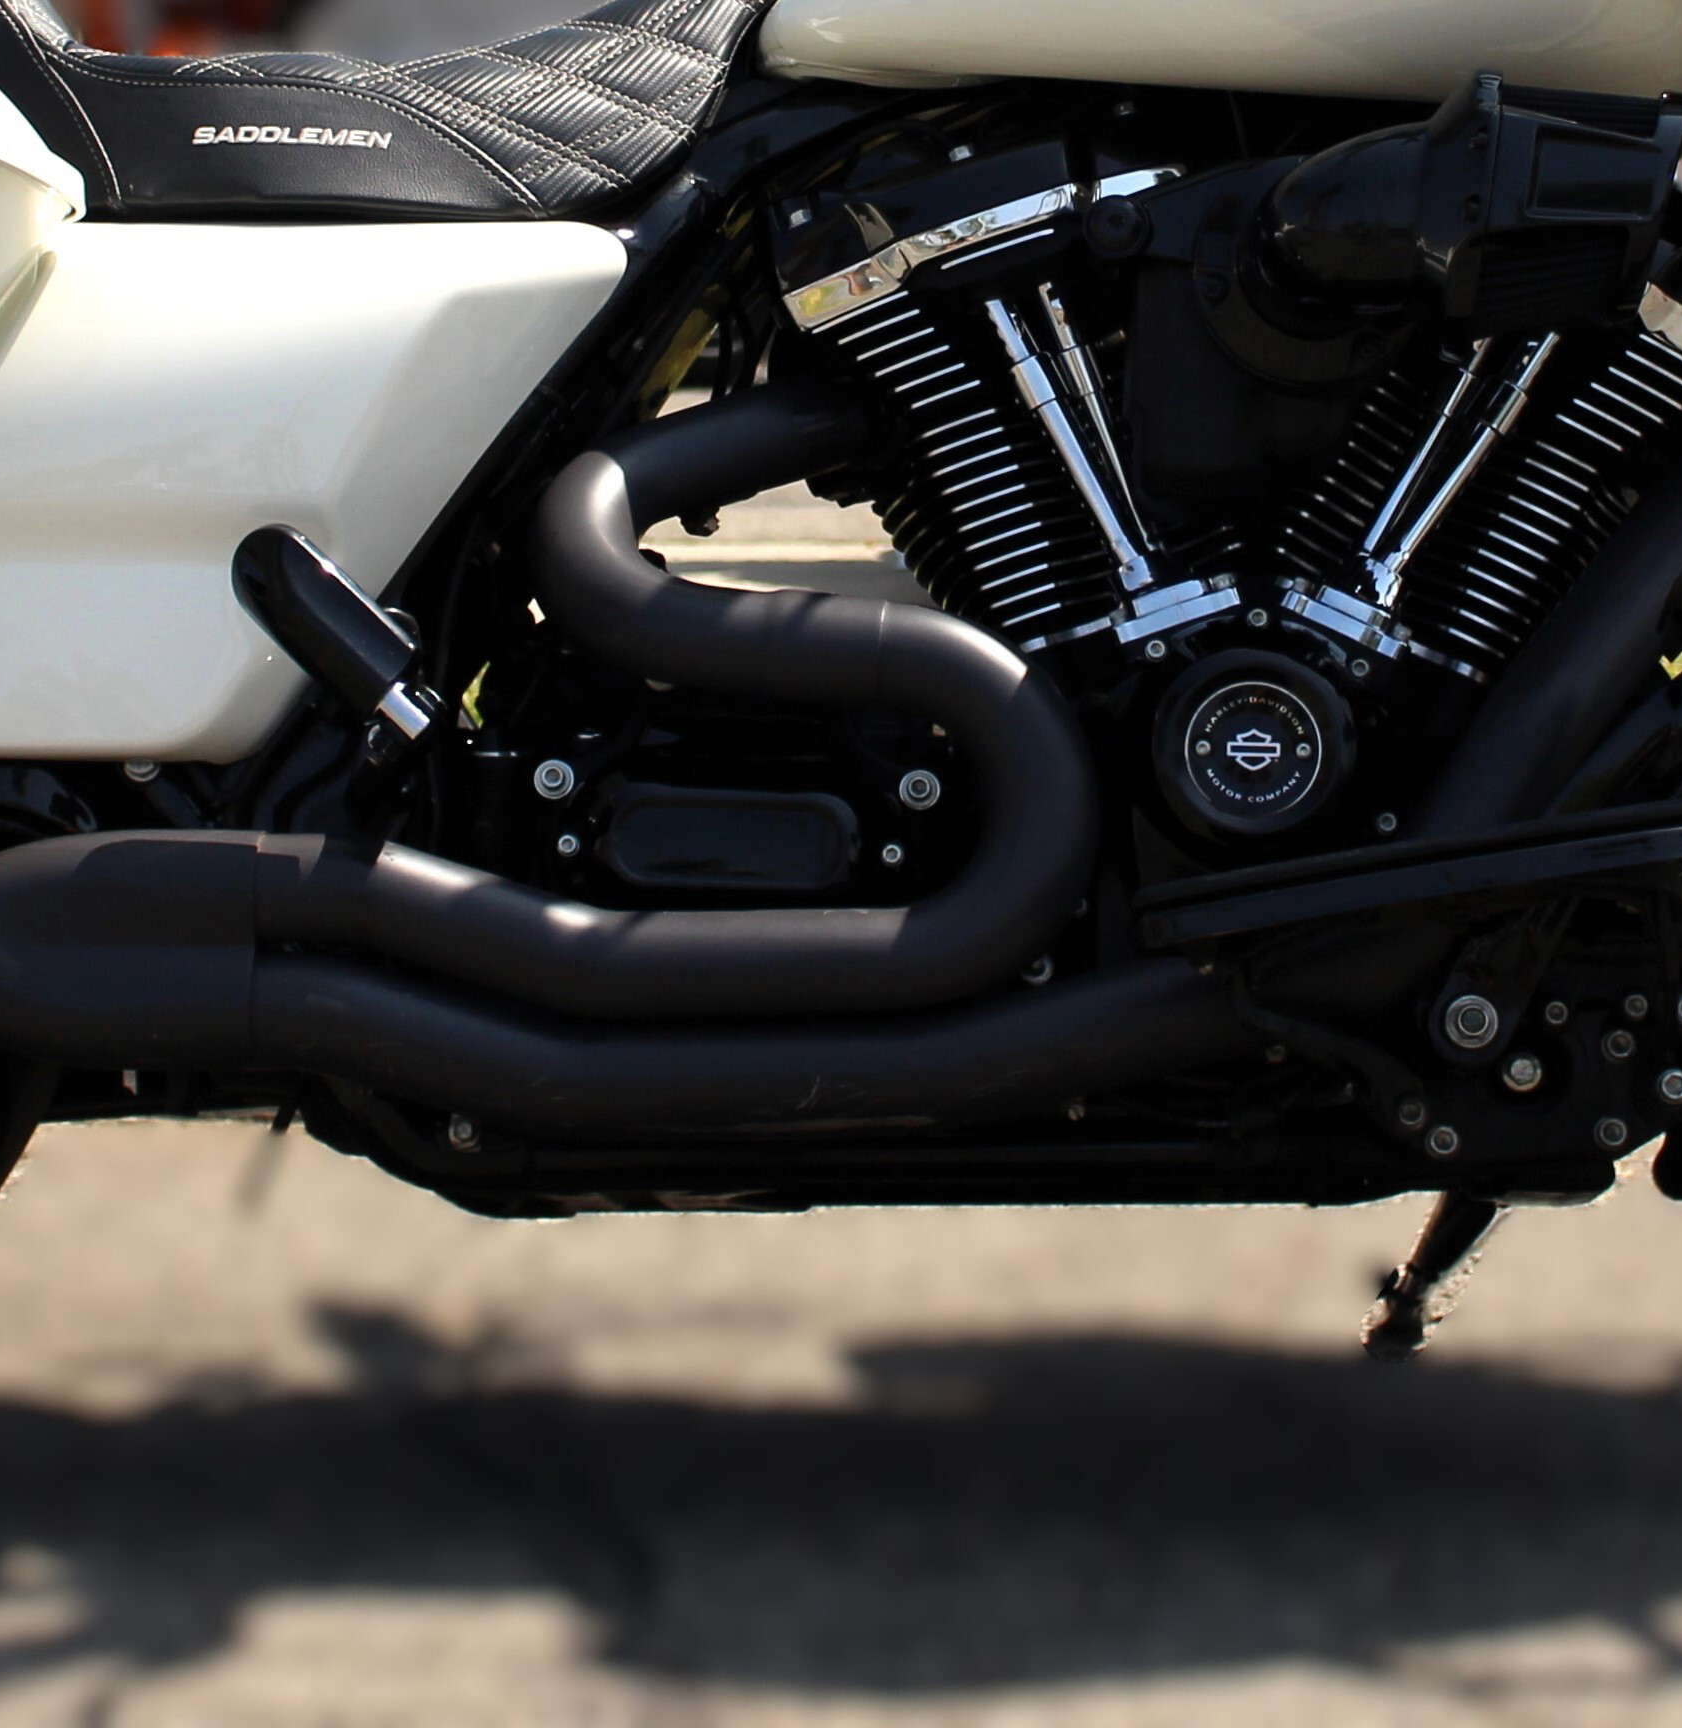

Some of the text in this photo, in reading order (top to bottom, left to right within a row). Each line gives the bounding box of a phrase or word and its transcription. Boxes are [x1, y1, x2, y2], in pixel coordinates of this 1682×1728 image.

[192, 125, 393, 150] SADDLEMEN
[1206, 768, 1302, 803] MOTOR COMPANY
